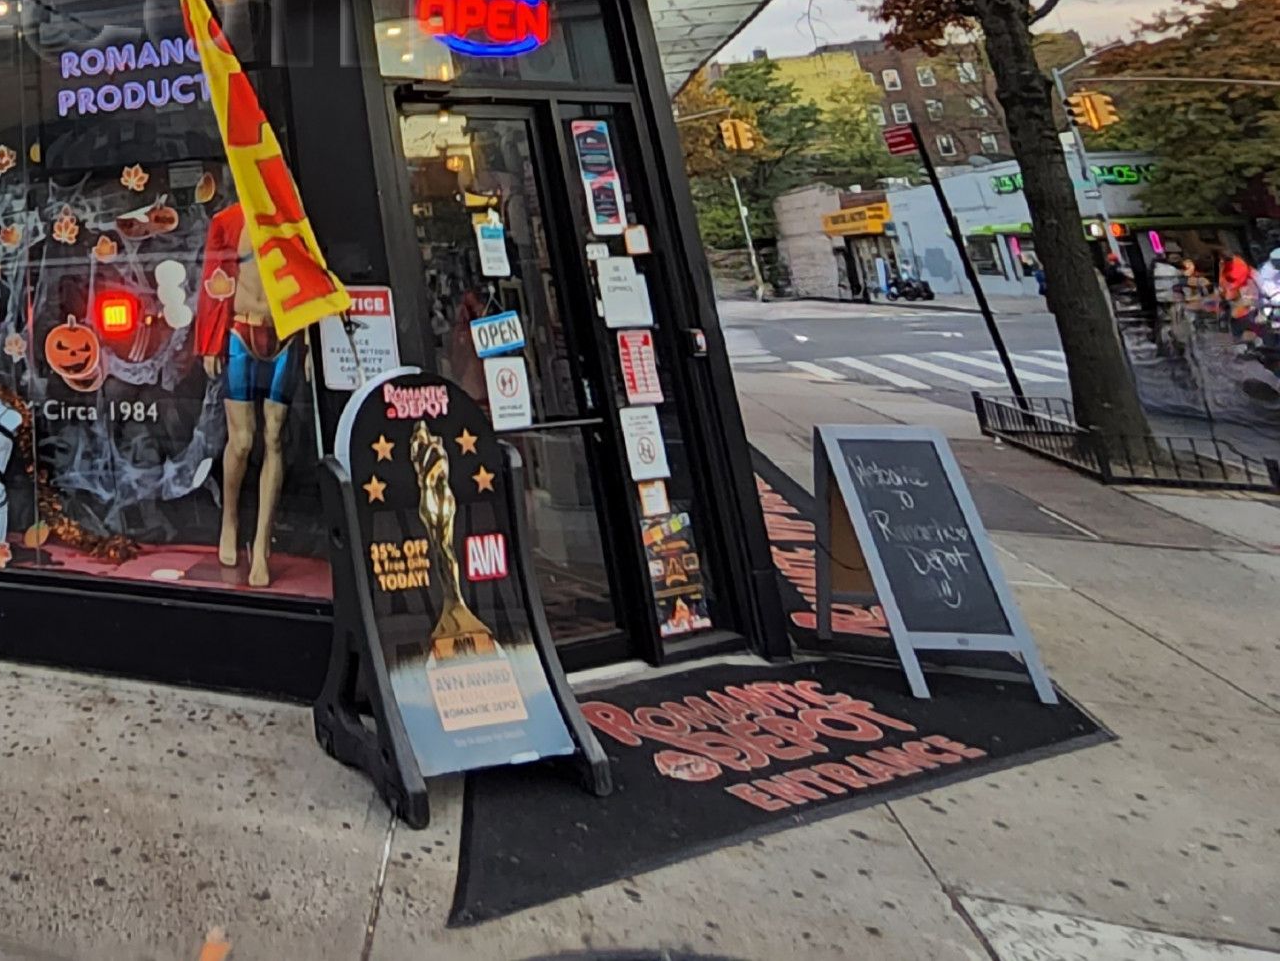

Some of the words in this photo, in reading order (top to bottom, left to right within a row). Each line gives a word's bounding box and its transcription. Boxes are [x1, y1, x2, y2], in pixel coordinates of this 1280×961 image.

[477, 319, 519, 350] OPEN
[383, 383, 448, 403] ROMANTIC
[43, 399, 98, 421] Circa
[109, 400, 158, 423] 1984
[395, 398, 449, 418] DEPOT
[403, 539, 429, 557] OFF
[467, 534, 507, 577] AVN
[379, 570, 430, 591] TODAY!
[581, 680, 853, 746] ROMANTIC
[687, 700, 918, 771] DEPOT
[725, 734, 987, 812] ENTRANCE
